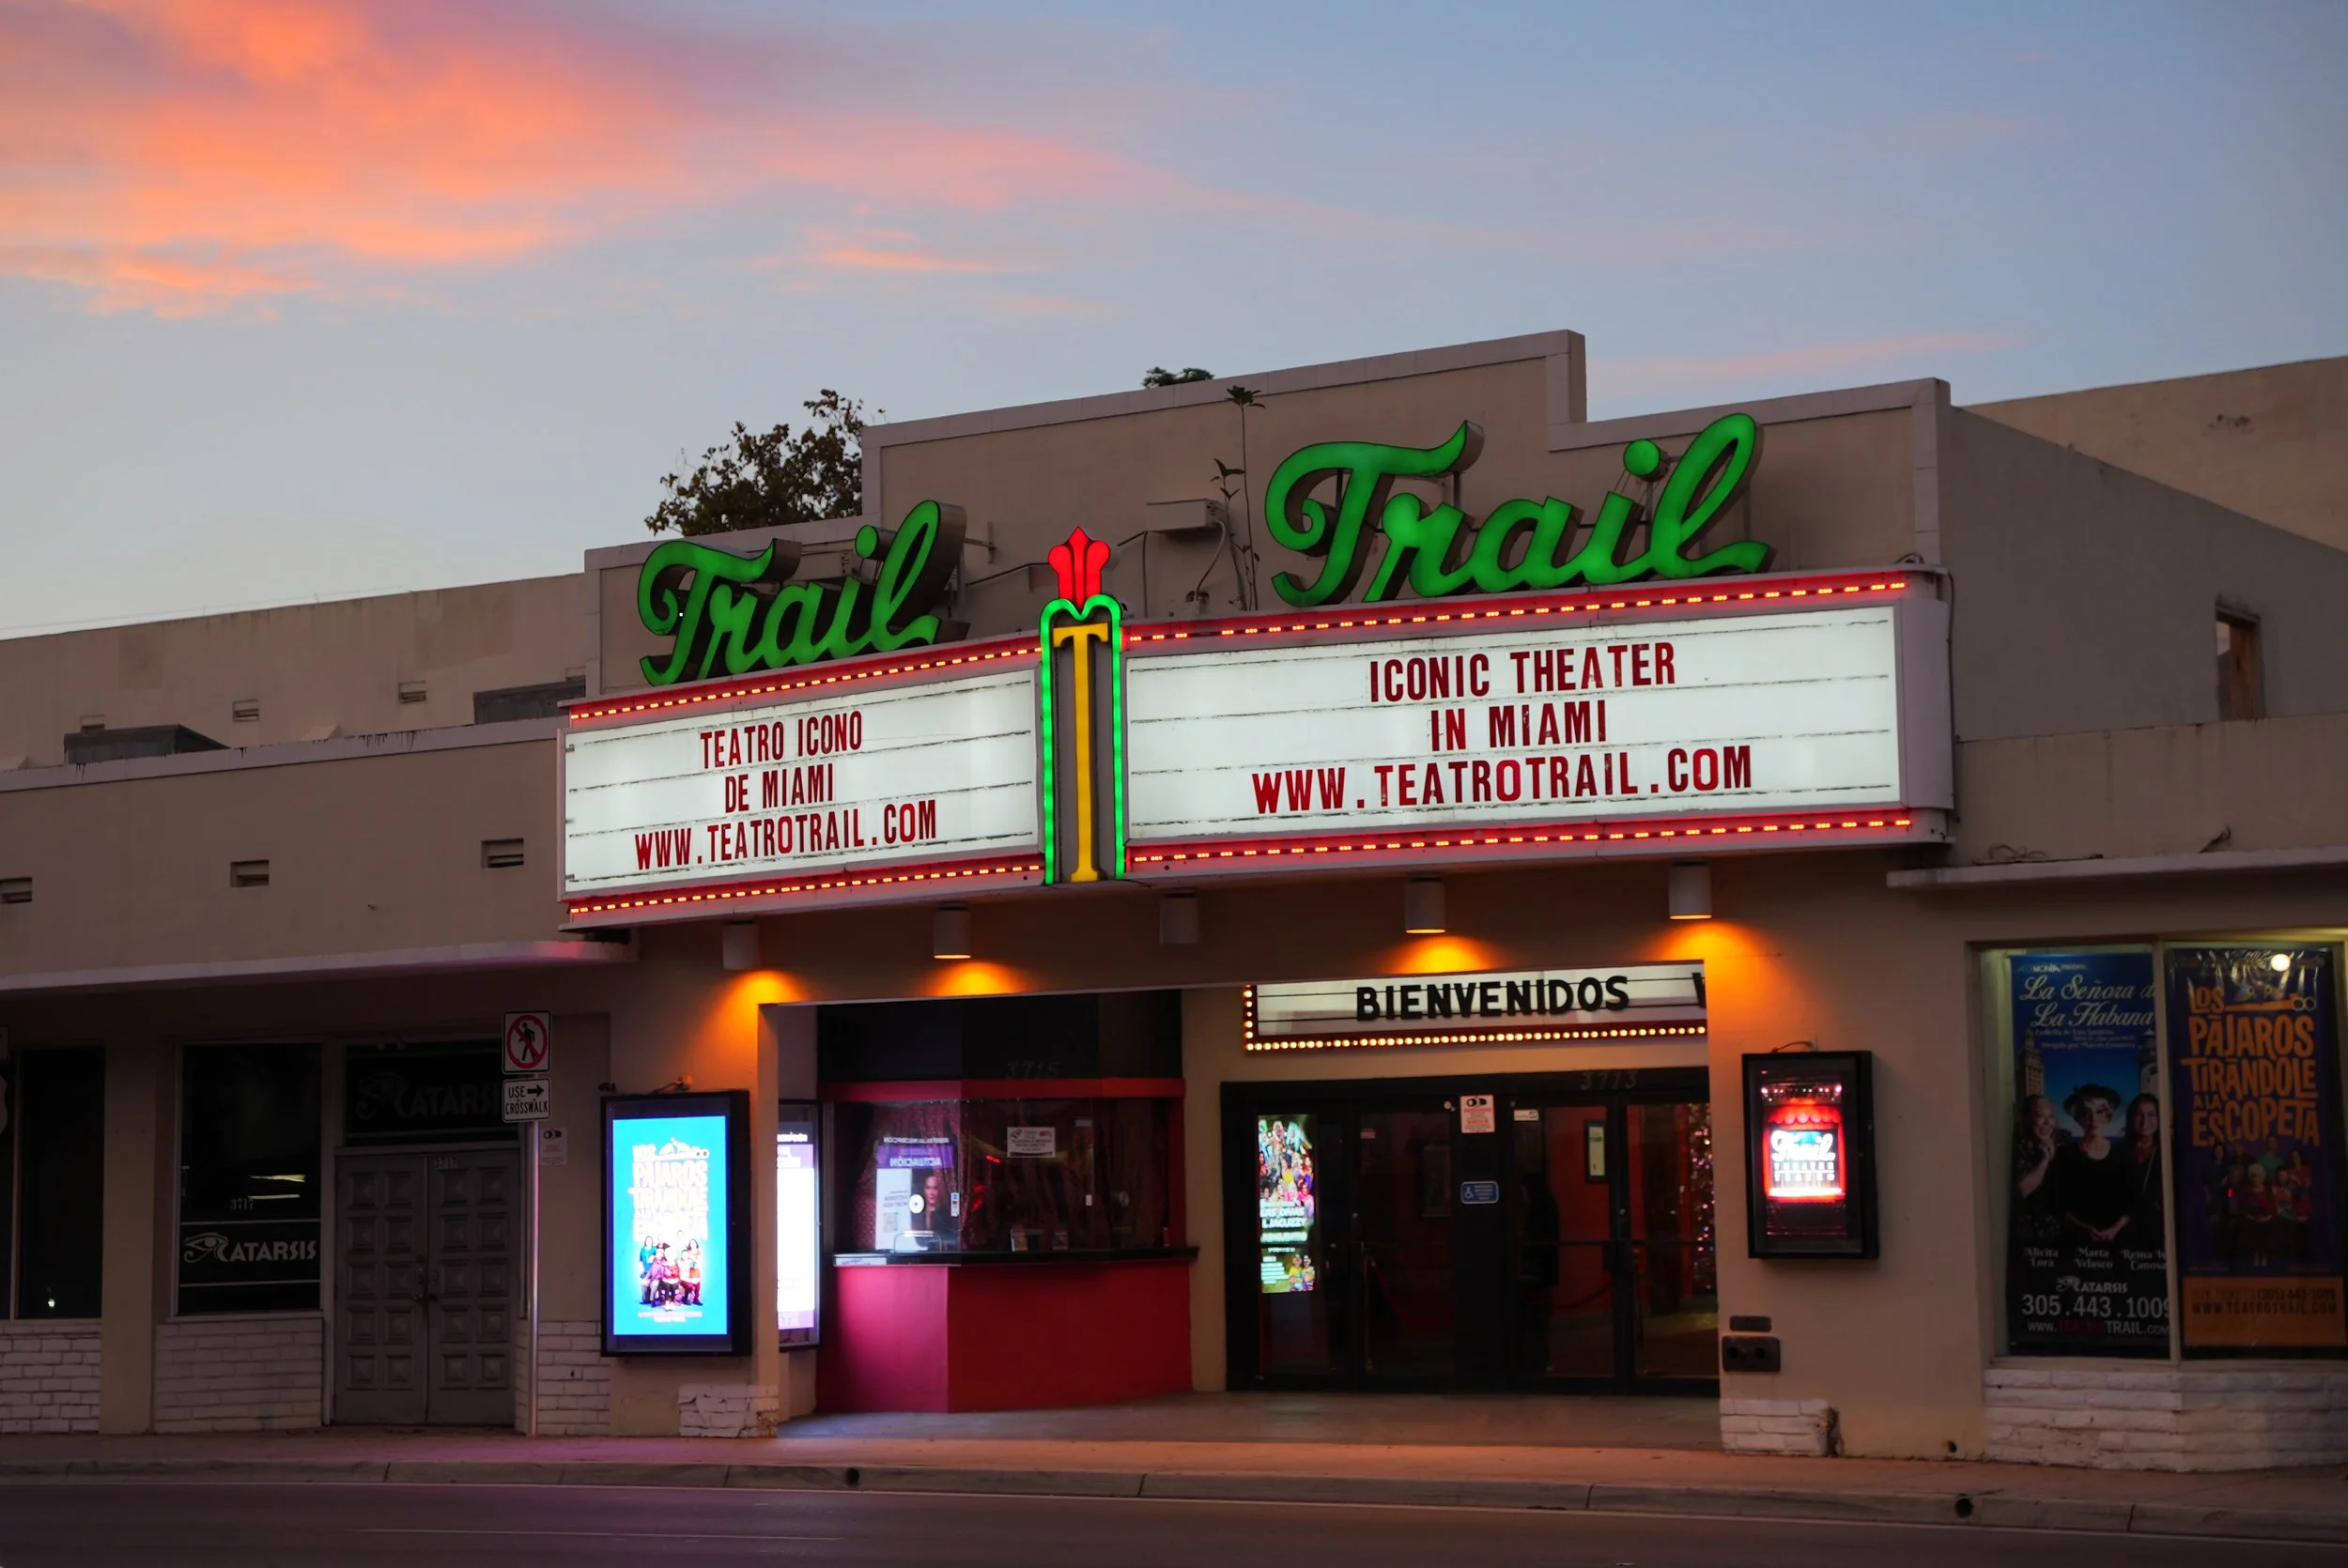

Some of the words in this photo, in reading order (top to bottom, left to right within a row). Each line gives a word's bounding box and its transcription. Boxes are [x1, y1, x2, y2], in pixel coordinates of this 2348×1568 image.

[1265, 413, 1774, 607] Trail
[638, 500, 942, 687] Trail
[1369, 653, 1491, 702] ICONIC
[1509, 641, 1676, 693] THEATER
[700, 720, 785, 769] TEATRO
[796, 710, 863, 757] ICONO
[1430, 707, 1467, 752] IN
[1488, 699, 1607, 748] MIAMI
[724, 773, 750, 814] DE
[762, 762, 834, 809] MIAMI
[1251, 744, 1752, 814] WWW.TEATROTRAIL.COM
[634, 798, 937, 870] WWW.TEATROTRAIL.COM
[1355, 975, 1630, 1022] BIENVENIDOS
[2018, 974, 2056, 1001] La
[2061, 974, 2136, 1001] Señora
[2187, 986, 2225, 1014] LOS
[2030, 1001, 2066, 1027] La
[2068, 1001, 2155, 1027] Habana
[505, 1099, 548, 1115] CROSSWALK
[508, 1085, 526, 1099] USE
[2193, 1094, 2203, 1110] A
[2205, 1094, 2221, 1110] LA
[2191, 1097, 2321, 1147] ESCOPETA
[215, 1238, 317, 1263] CATARSIS
[2077, 1246, 2110, 1258] Marta
